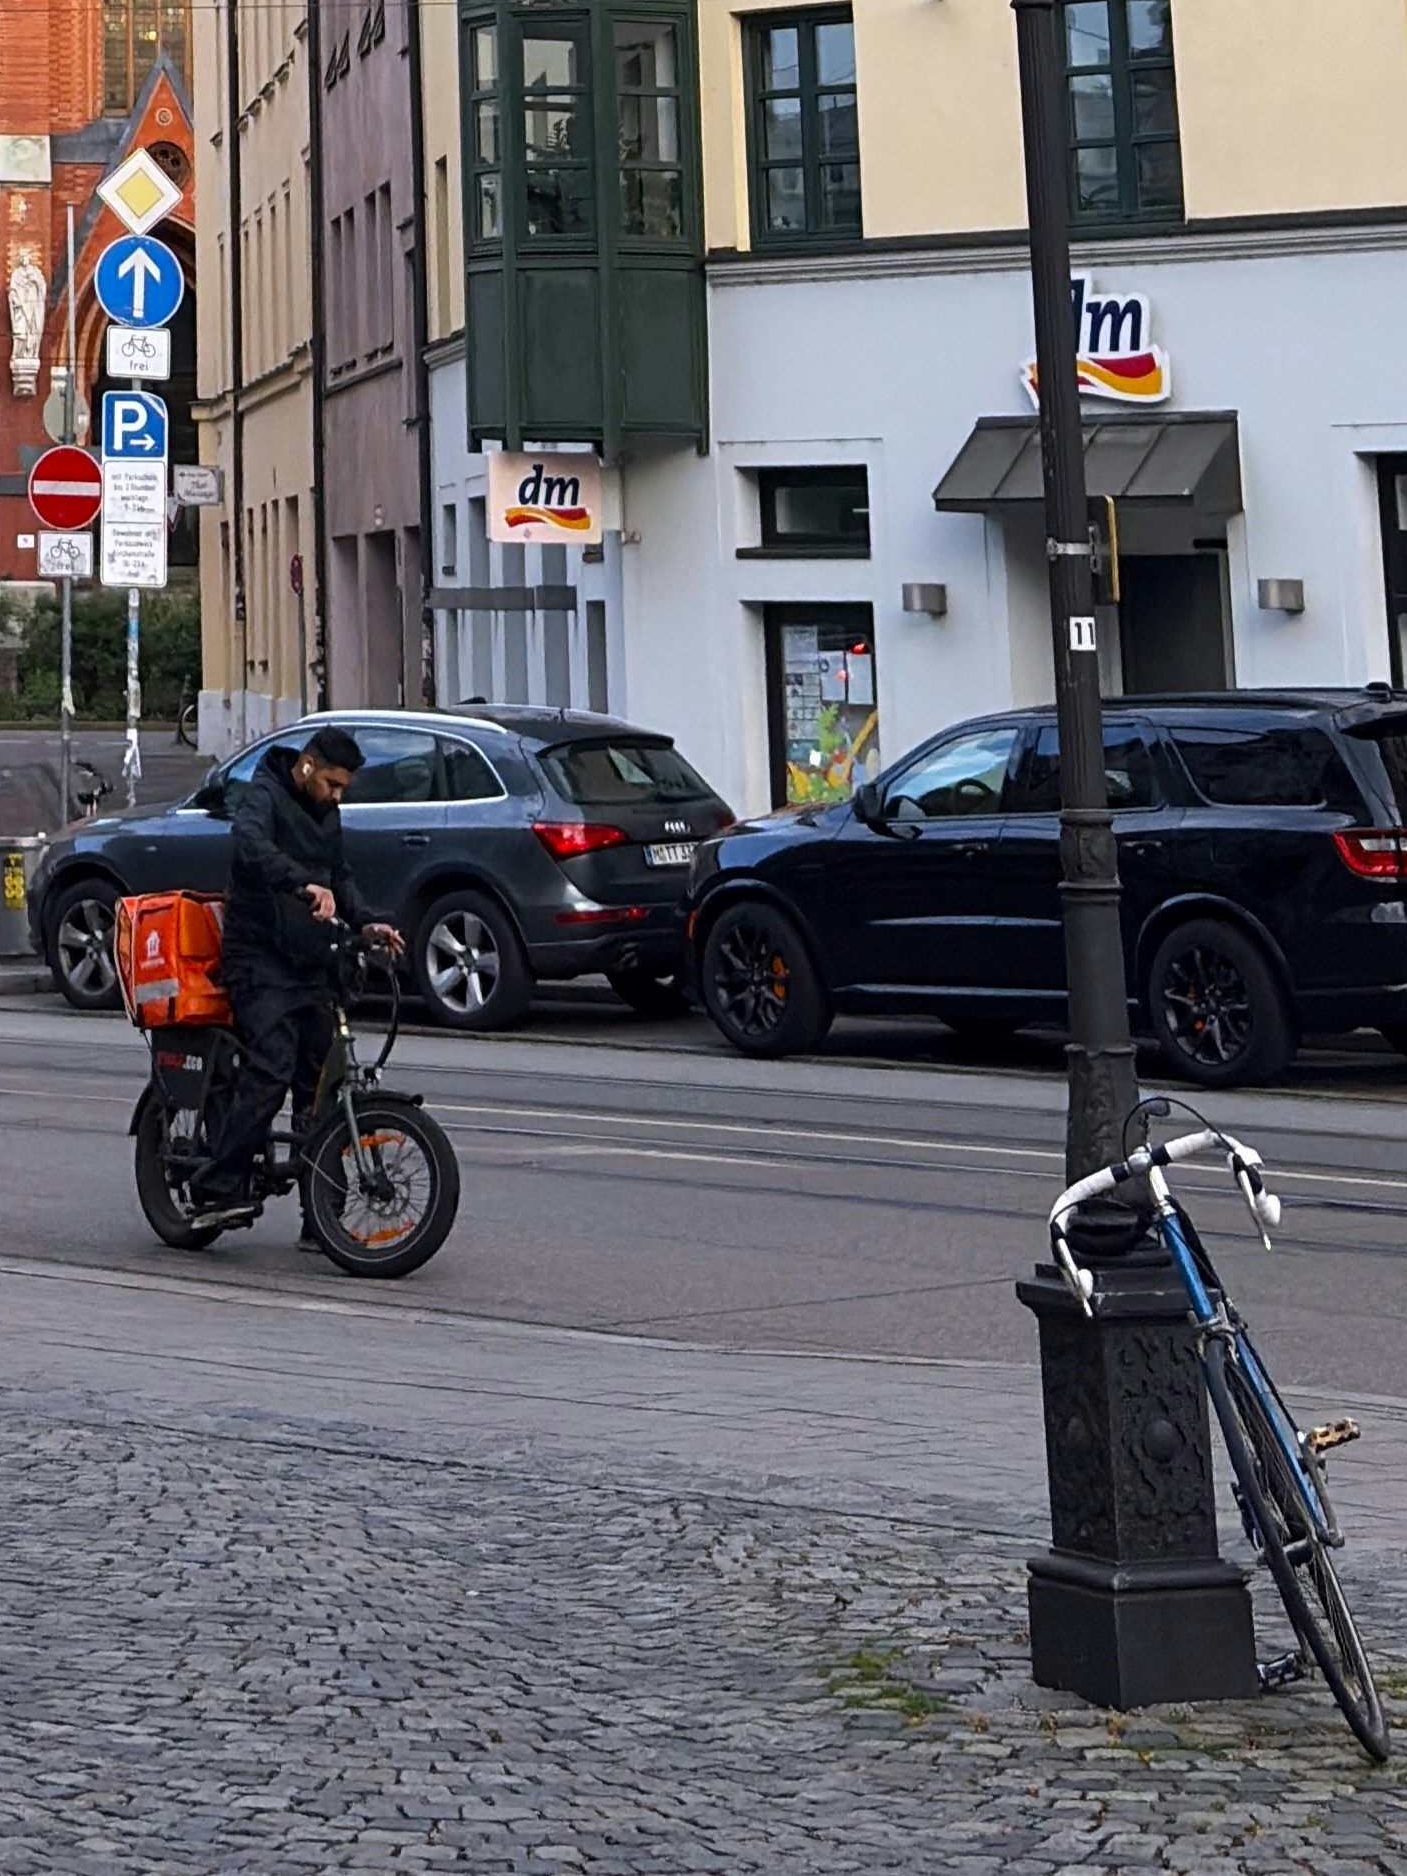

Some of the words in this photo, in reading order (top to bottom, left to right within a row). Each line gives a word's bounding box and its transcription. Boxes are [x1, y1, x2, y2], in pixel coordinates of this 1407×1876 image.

[129, 360, 149, 372] frei
[113, 400, 147, 451] P
[518, 464, 580, 505] dm
[1074, 621, 1095, 646] 11
